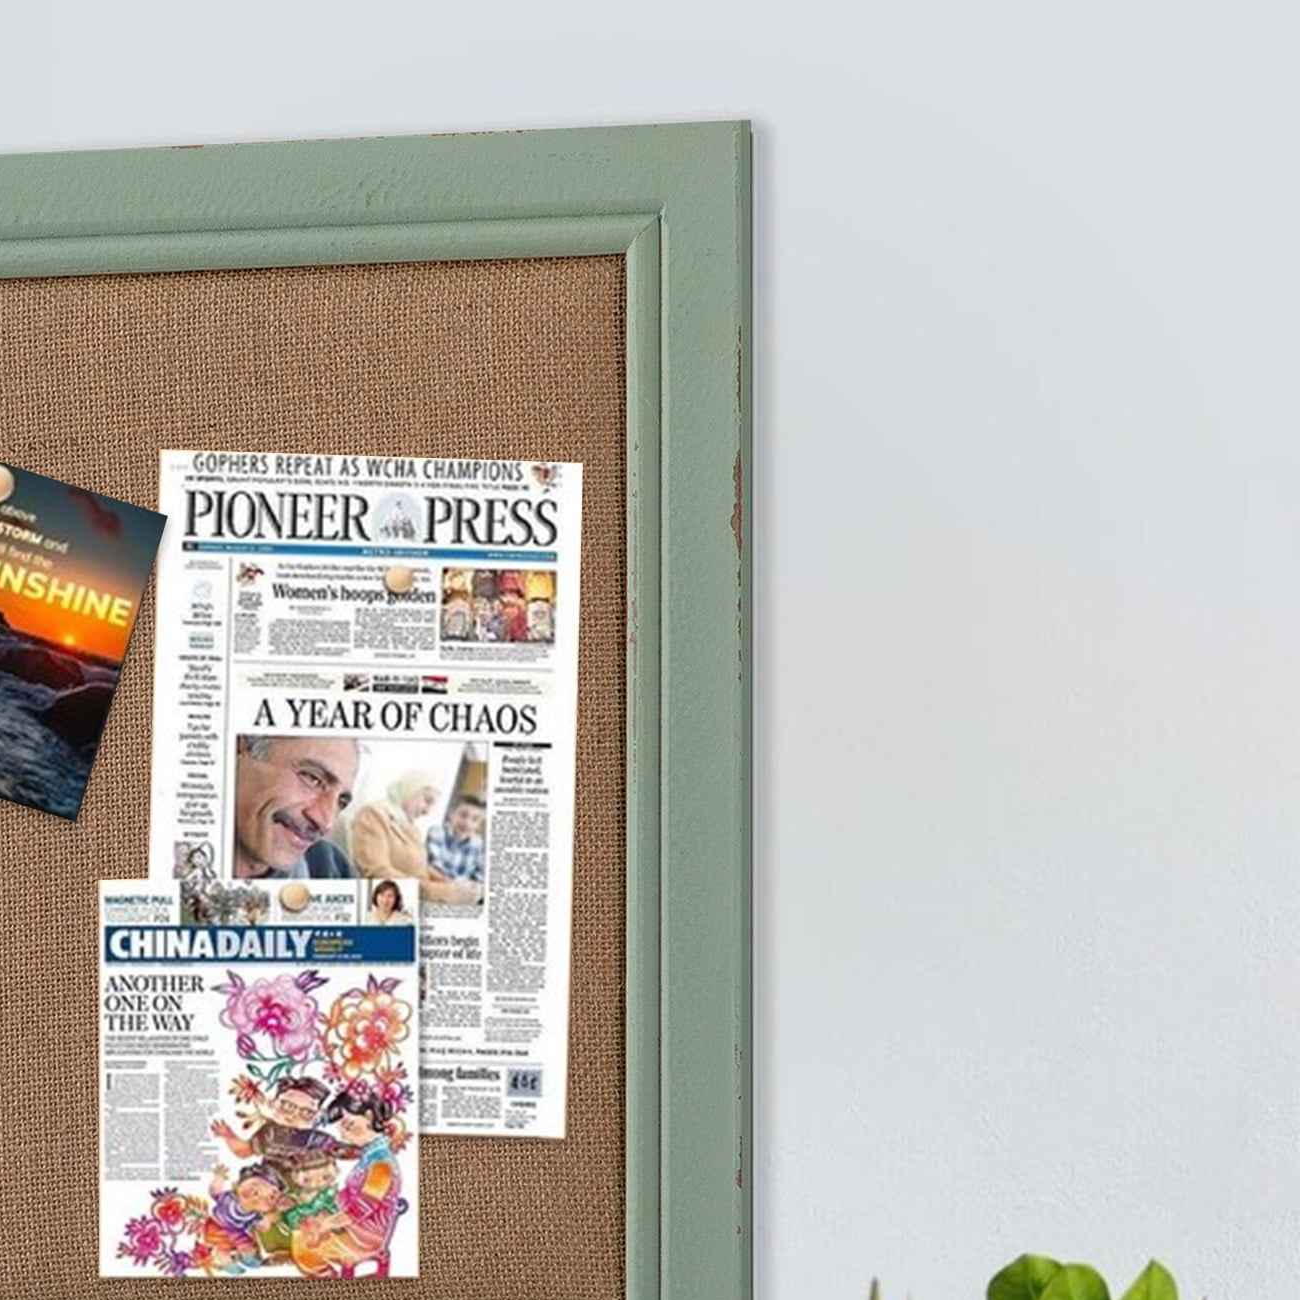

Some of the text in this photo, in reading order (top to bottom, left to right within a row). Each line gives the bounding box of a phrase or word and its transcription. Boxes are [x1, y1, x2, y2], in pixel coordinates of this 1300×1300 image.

[192, 453, 524, 482] GOPHERS REPEAT AS WCHA CHAMPIONS
[0, 504, 37, 523] above
[184, 489, 558, 547] PIONEER PRESS
[44, 537, 69, 553] and
[8, 545, 31, 563] find
[31, 551, 54, 567] the
[272, 582, 339, 602] Women's
[341, 585, 384, 605] hoops
[253, 698, 537, 735] A YEAR OF CHAOS
[104, 974, 205, 993] ANOTHER
[104, 994, 184, 1012] ONE ON
[104, 1013, 195, 1031] THE WAY
[456, 1066, 501, 1081] families
